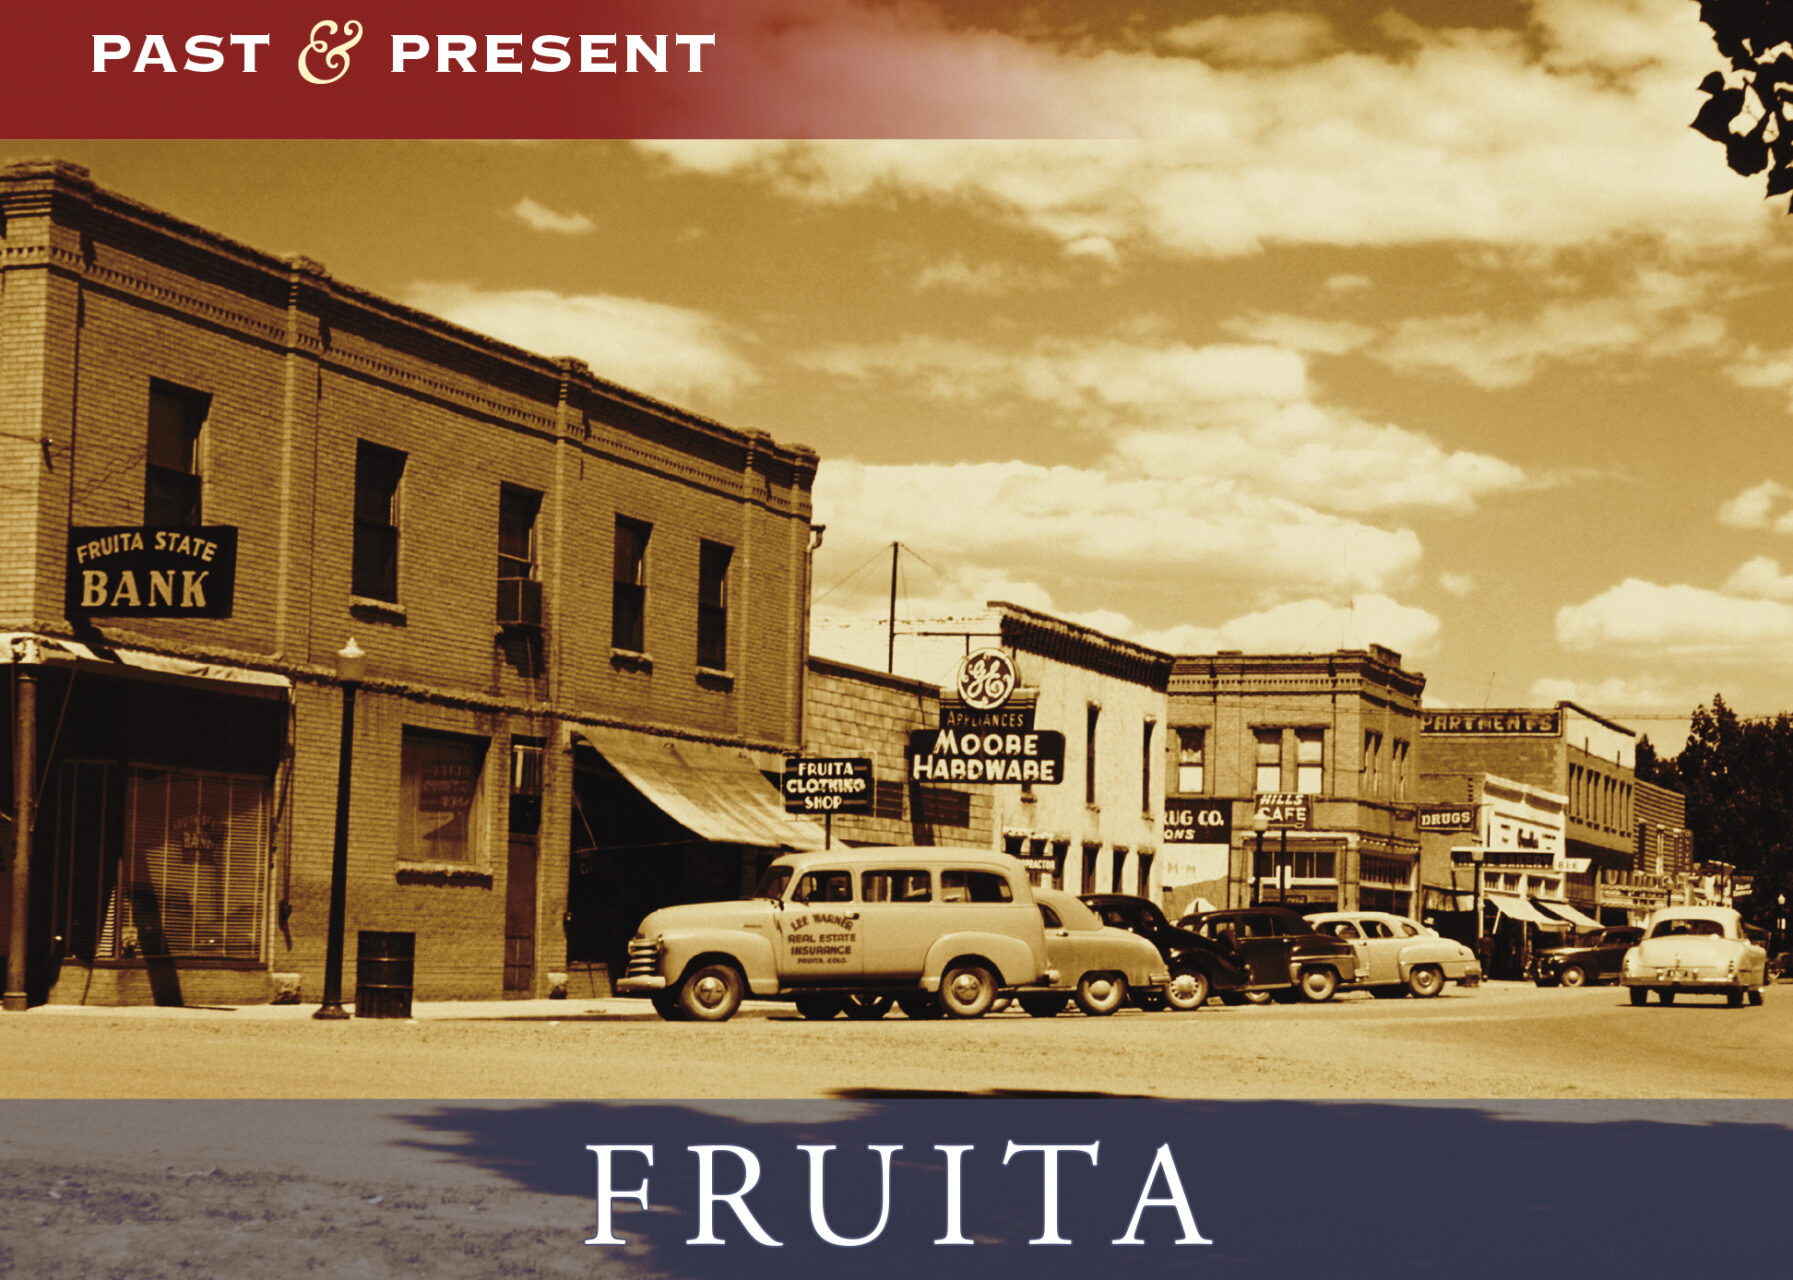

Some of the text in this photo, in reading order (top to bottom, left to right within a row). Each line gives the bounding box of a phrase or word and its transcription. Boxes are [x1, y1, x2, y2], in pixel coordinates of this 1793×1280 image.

[76, 531, 218, 564] FRUITA STATE
[80, 570, 209, 607] BANK
[947, 710, 1025, 727] APPLIANCES
[933, 729, 1039, 756] MOORE
[798, 762, 854, 776] FRUITA
[913, 754, 1055, 781] HARDWARE
[786, 778, 866, 794] CLOTHING
[804, 795, 842, 810] SHOP
[1259, 794, 1304, 806] HILLS
[1197, 810, 1225, 826] CO.
[1258, 806, 1307, 821] CAFE
[1421, 812, 1471, 826] DRUGS
[790, 916, 809, 931] LEE
[788, 933, 856, 943] REAL ESTATE
[791, 945, 852, 955] INSURANCE
